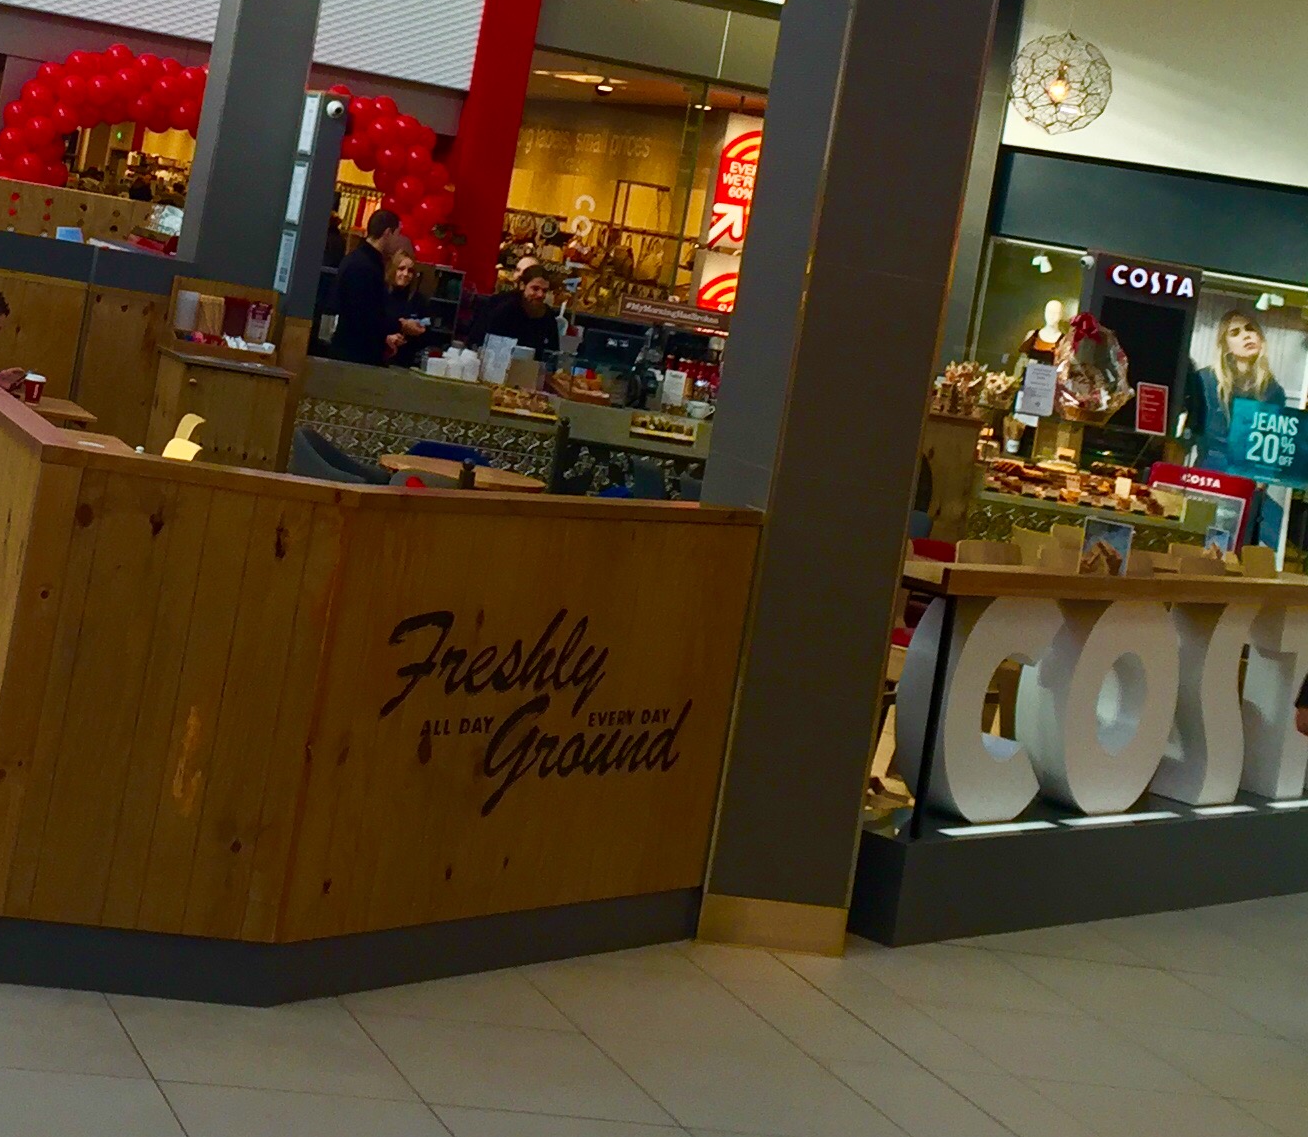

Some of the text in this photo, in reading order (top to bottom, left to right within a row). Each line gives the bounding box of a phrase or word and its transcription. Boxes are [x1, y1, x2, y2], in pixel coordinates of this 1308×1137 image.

[722, 172, 755, 188] WE'R
[1110, 264, 1194, 298] COSTA
[1250, 411, 1300, 436] JEANS
[1246, 431, 1296, 467] 20% OFF
[1180, 473, 1222, 489] COSTA
[379, 607, 610, 718] Freshly
[420, 708, 672, 737] ALL DAY EVERY DAY
[480, 693, 693, 818] Ground
